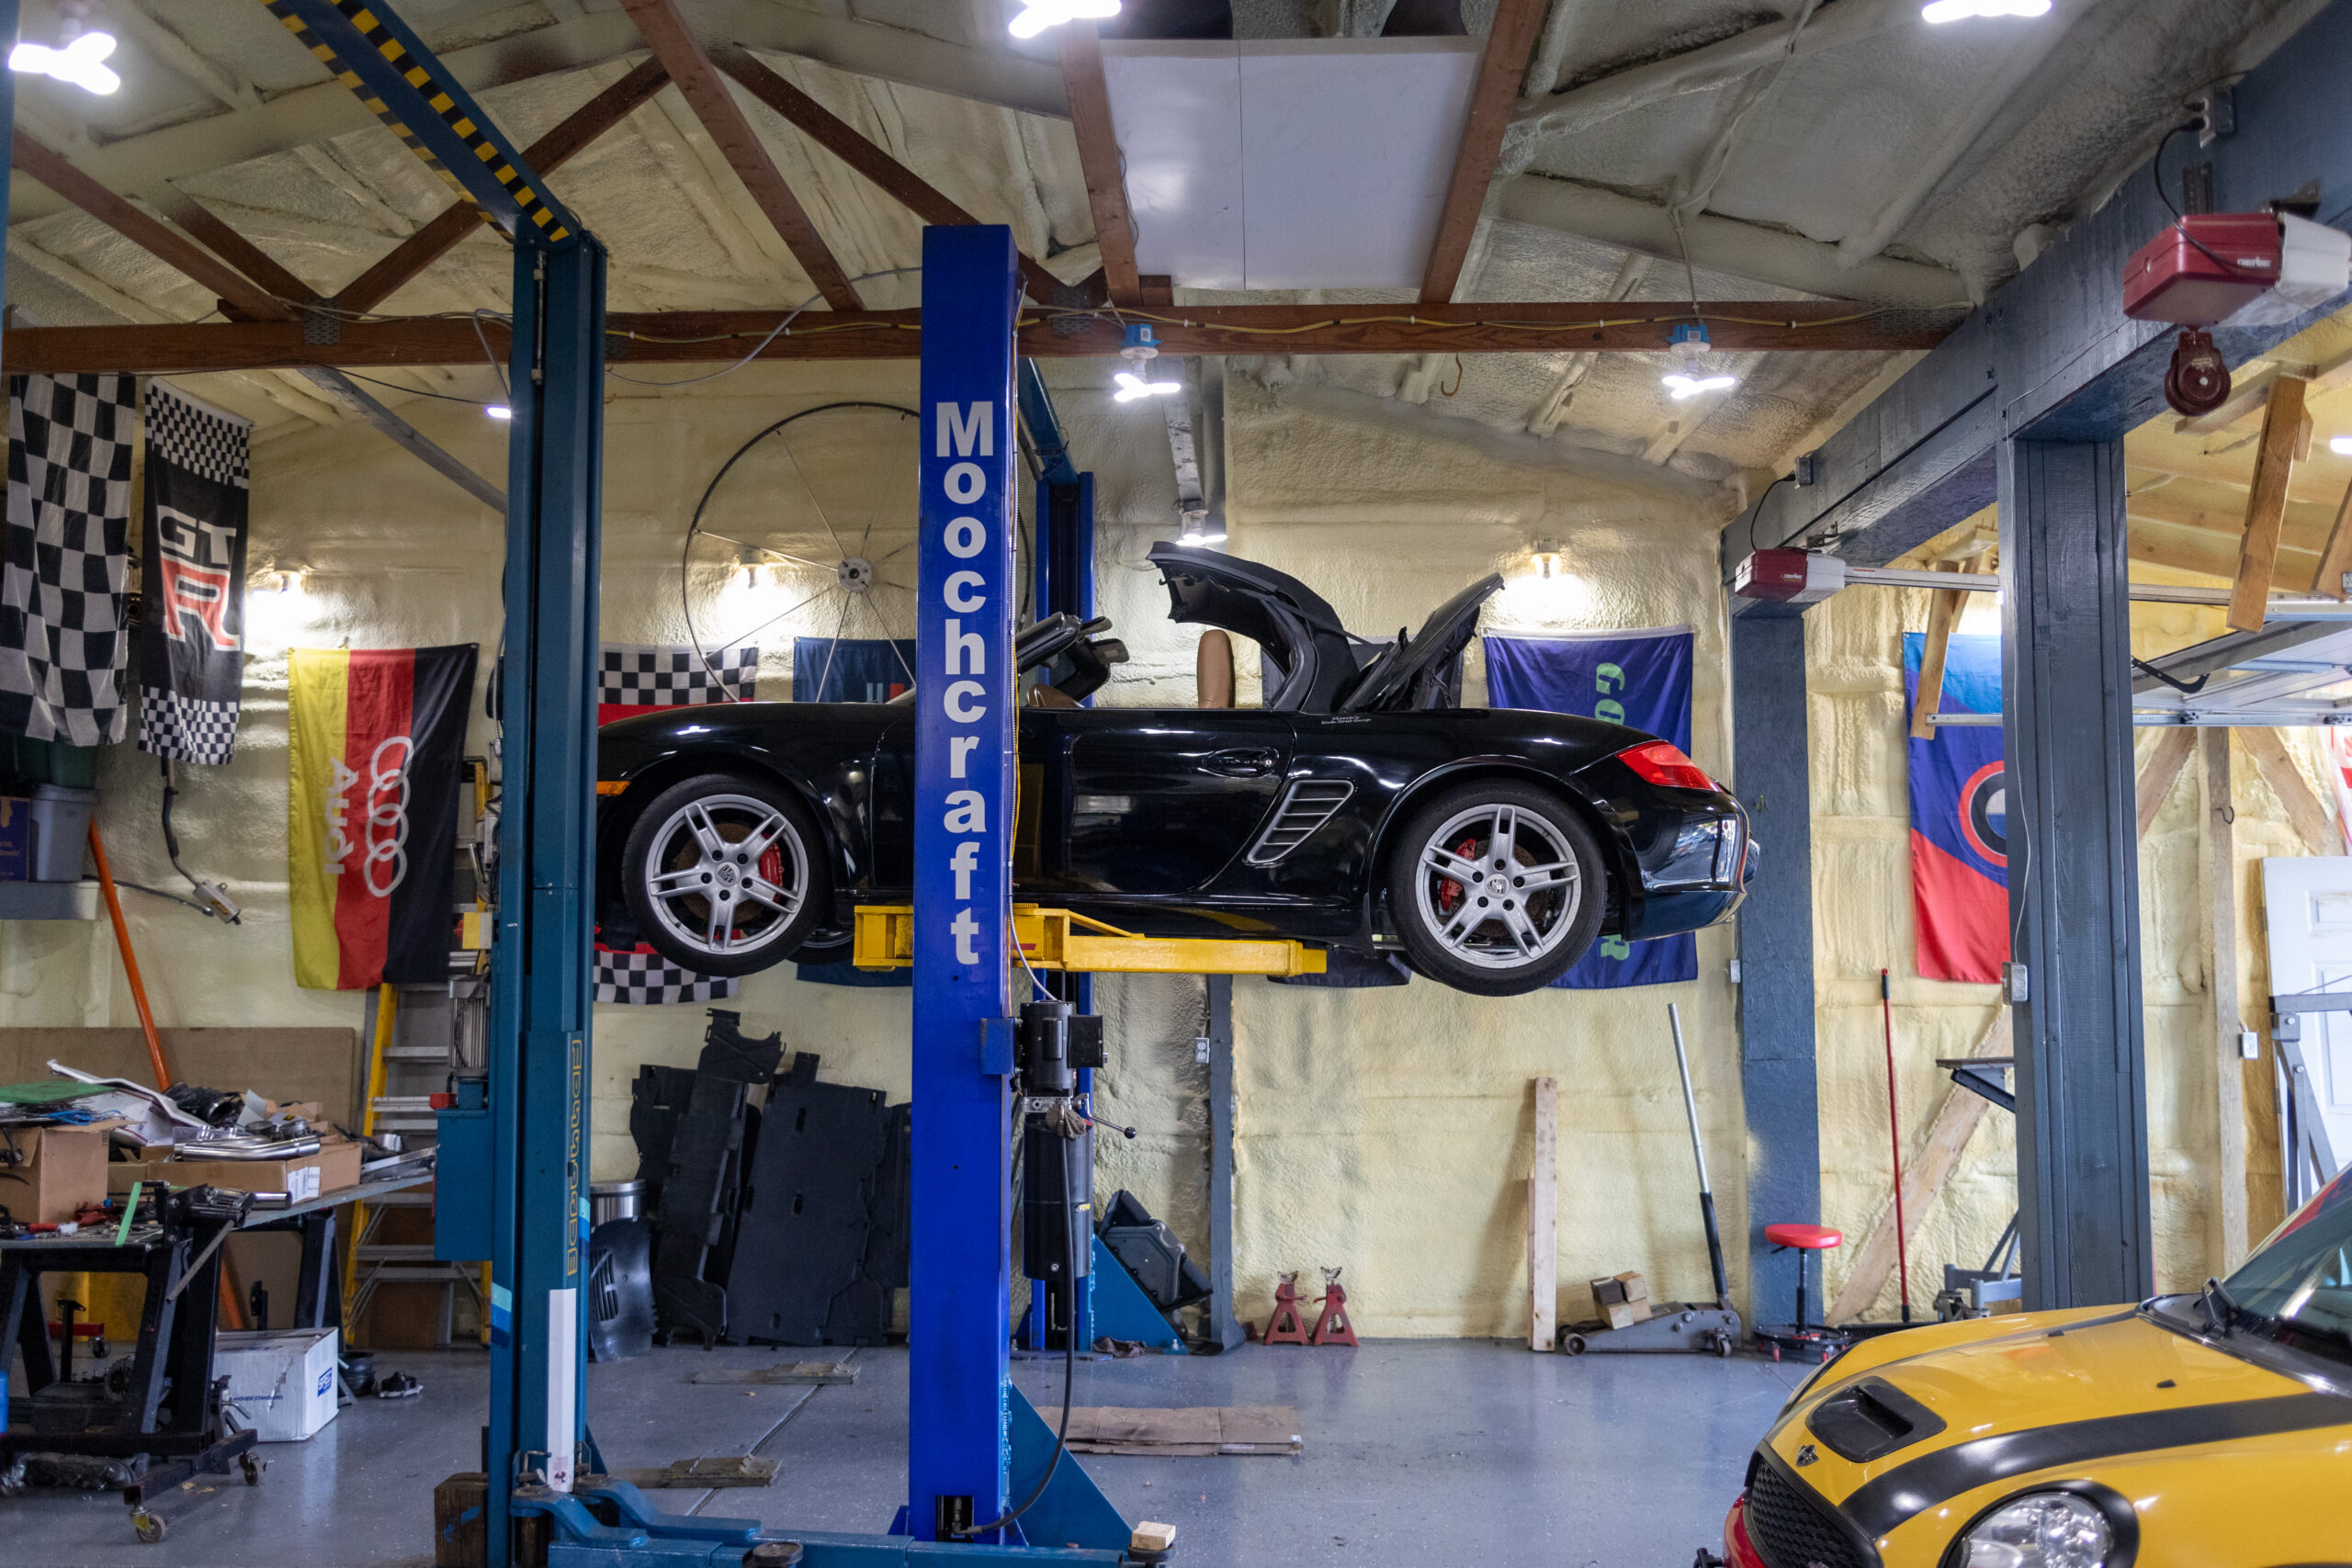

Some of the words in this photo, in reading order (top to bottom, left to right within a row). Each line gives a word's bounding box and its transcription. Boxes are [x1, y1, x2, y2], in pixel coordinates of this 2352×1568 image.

[157, 505, 237, 565] GT
[935, 400, 994, 964] Moochcraft
[324, 757, 359, 874] Audi
